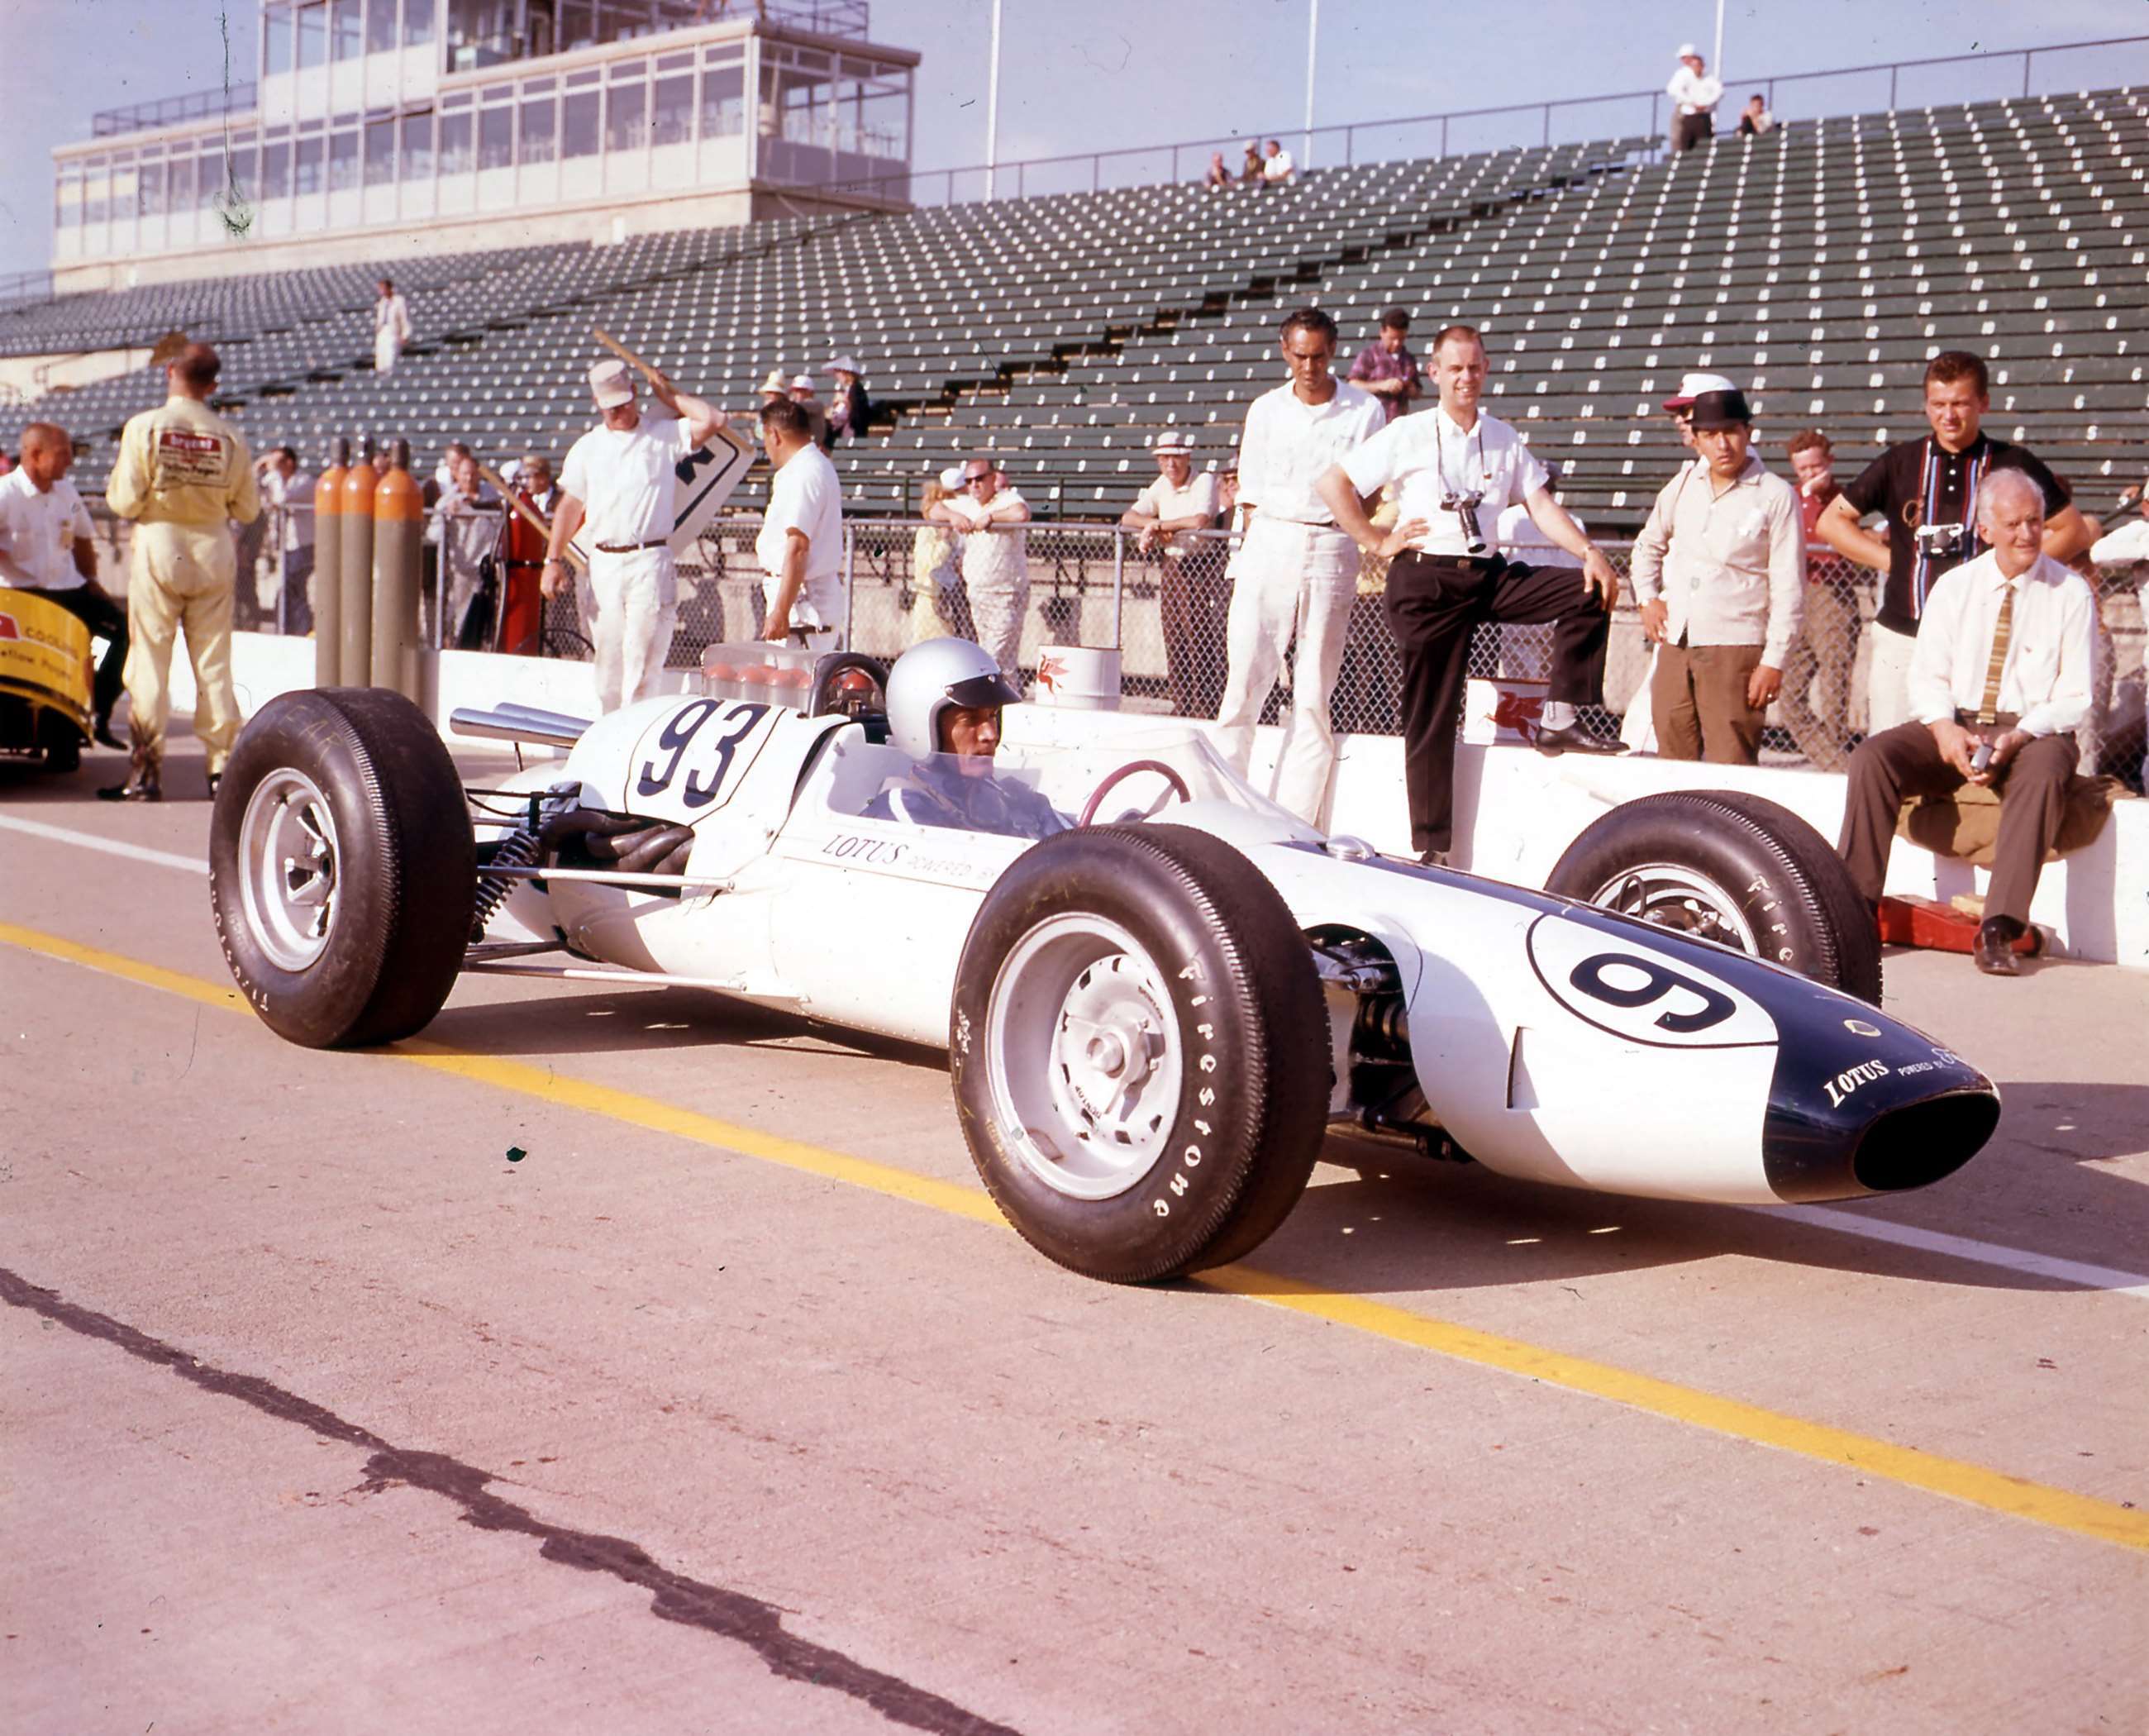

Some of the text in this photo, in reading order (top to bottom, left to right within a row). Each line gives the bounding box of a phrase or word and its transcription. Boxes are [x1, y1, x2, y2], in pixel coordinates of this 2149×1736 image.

[636, 697, 770, 808] 93
[822, 834, 909, 864] LOTUS
[1154, 959, 1217, 1217] Firestone
[1823, 1060, 1890, 1108] LOTUS
[1898, 1061, 1933, 1076] POWERED
